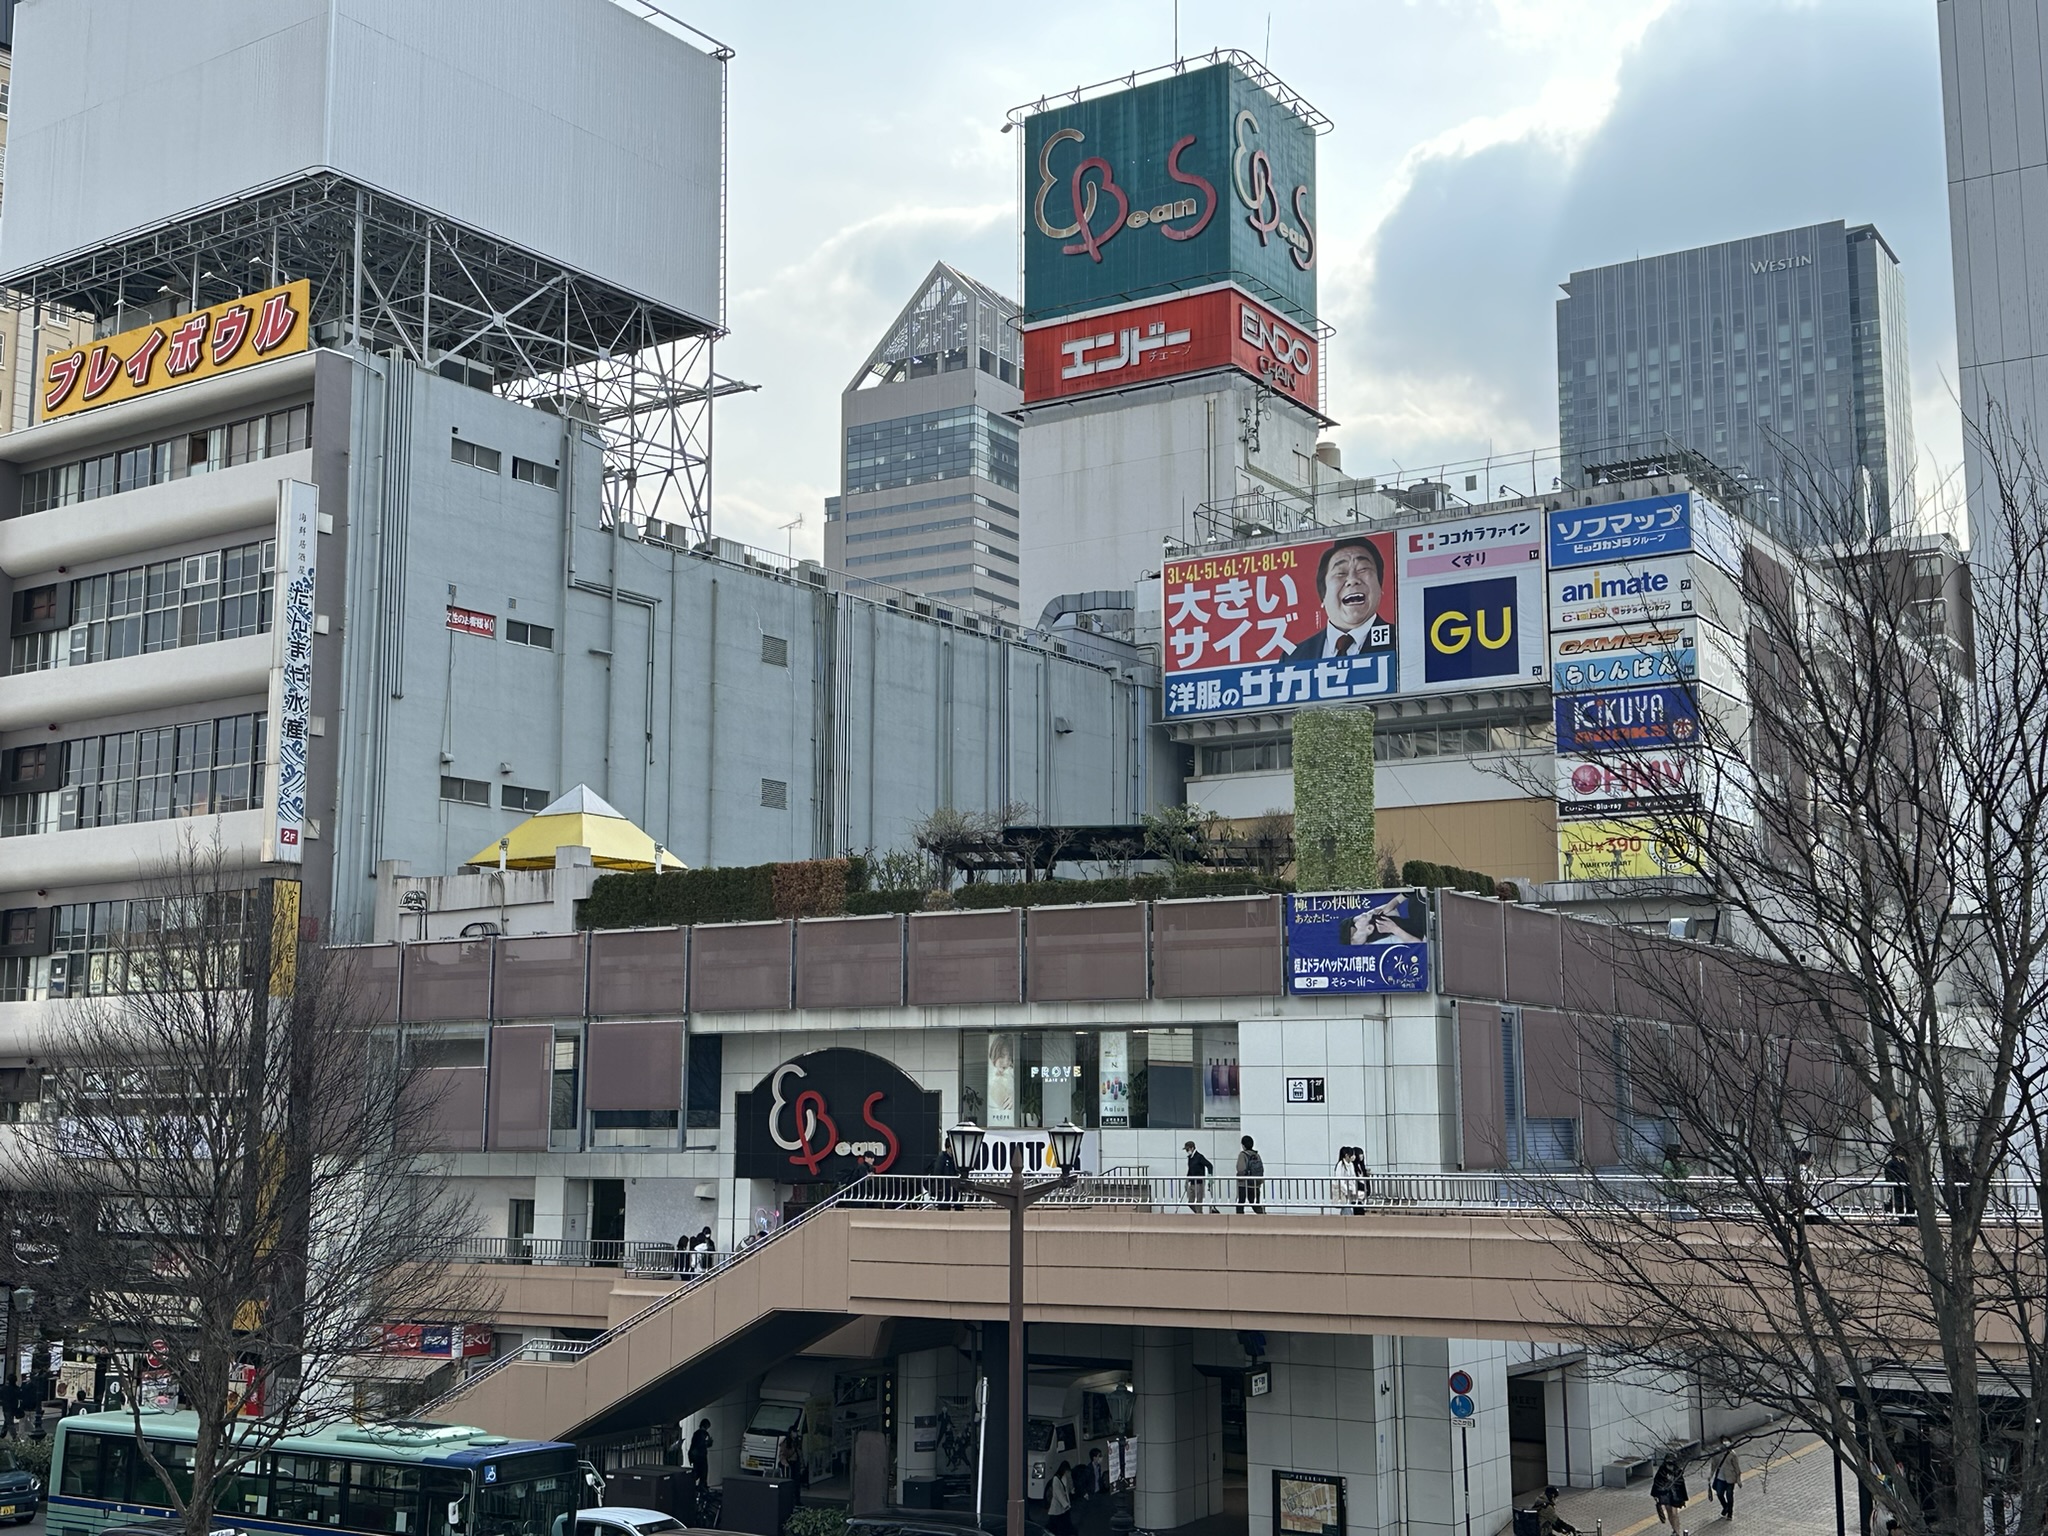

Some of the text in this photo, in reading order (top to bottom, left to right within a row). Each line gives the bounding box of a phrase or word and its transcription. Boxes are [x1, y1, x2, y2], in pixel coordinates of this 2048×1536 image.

[1750, 254, 1812, 274] WESTIN
[47, 292, 298, 411] プレイボウル
[1062, 321, 1191, 379] エンドー
[1241, 302, 1312, 375] ENDO
[1149, 346, 1192, 363] チェーン
[1259, 355, 1297, 392] CHAIN
[1439, 523, 1530, 546] ココカラファイン
[1557, 504, 1682, 541] ソフマップ
[1574, 534, 1666, 554] ビックカメラグループ
[1451, 551, 1486, 567] くすり
[1562, 571, 1669, 603] animate
[1168, 574, 1298, 628] 大きい
[1170, 612, 1299, 668] サイズ
[1373, 629, 1388, 642] 3F
[1430, 606, 1512, 654] GU
[1559, 629, 1684, 655] GAMERS
[1169, 655, 1390, 713] 洋服のサカゼン
[1566, 656, 1677, 685] らしんばん
[283, 831, 296, 842] 2F
[1294, 895, 1371, 912] 極上の快眠を
[1305, 978, 1318, 987] 3F
[1031, 1066, 1082, 1078] PROVE
